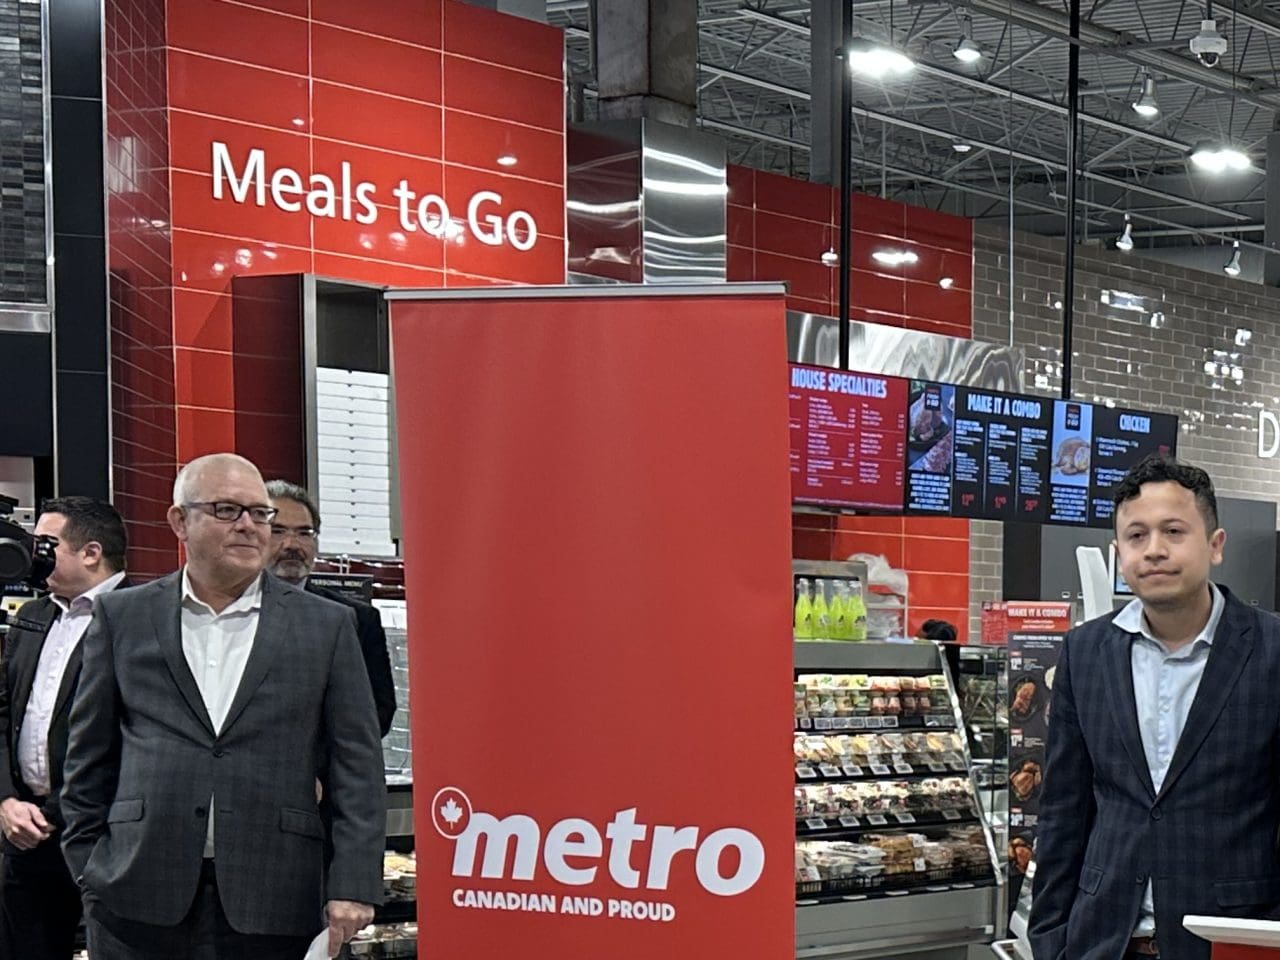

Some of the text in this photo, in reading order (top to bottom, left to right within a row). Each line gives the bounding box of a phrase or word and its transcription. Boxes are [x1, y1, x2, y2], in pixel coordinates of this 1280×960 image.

[212, 141, 538, 251] Meals to Go
[791, 367, 887, 399] HOUSE SPECIALTIES
[967, 393, 1041, 419] MAKE IT A COMBO
[1120, 414, 1151, 434] CHICKEN
[1008, 608, 1067, 618] MAKE IT A COMBO
[452, 807, 765, 896] metro
[453, 888, 676, 922] CANADIAN AND PROUD
